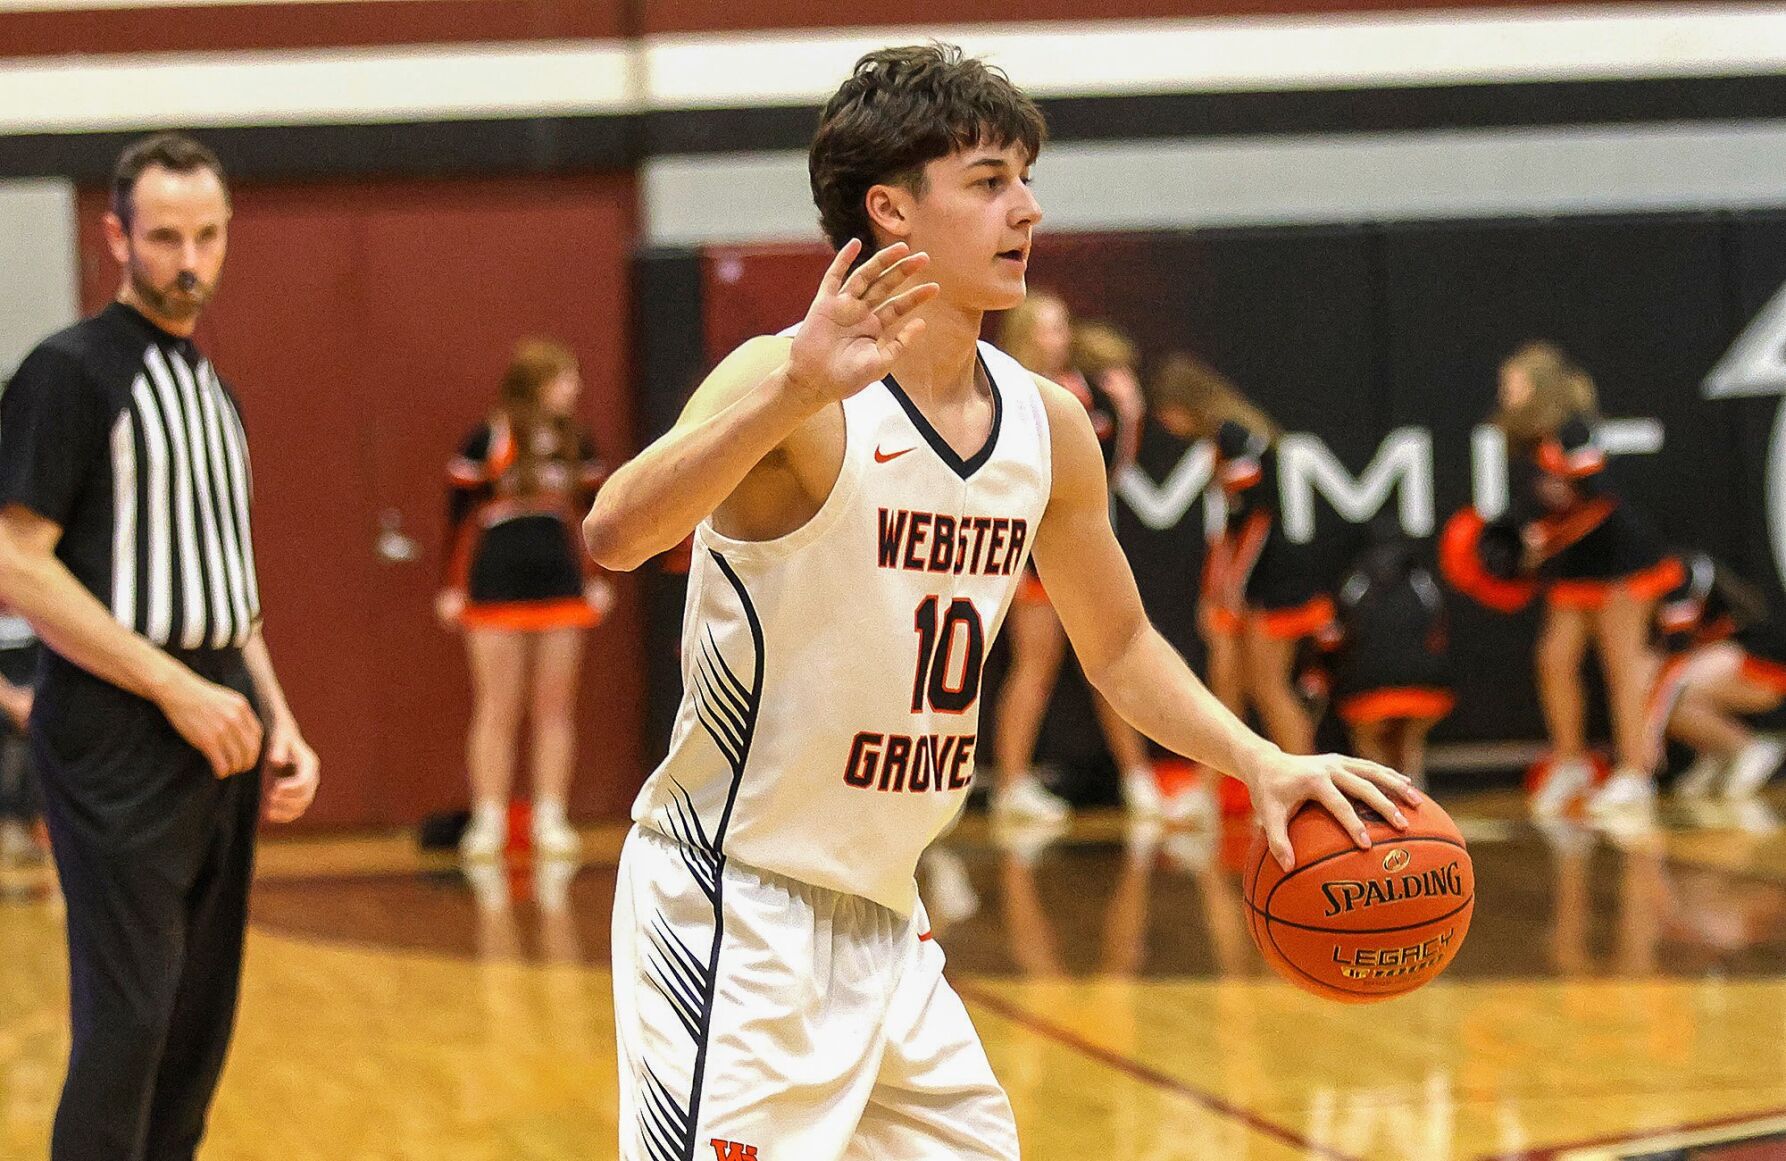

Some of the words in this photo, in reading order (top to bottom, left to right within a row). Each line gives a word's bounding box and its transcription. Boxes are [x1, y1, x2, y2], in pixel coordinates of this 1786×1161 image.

[877, 507, 1028, 576] WEBSTER
[910, 594, 985, 715] 10
[843, 730, 976, 793] GROVE
[1321, 861, 1463, 917] SPALDING
[1332, 927, 1455, 968] LEGACY
